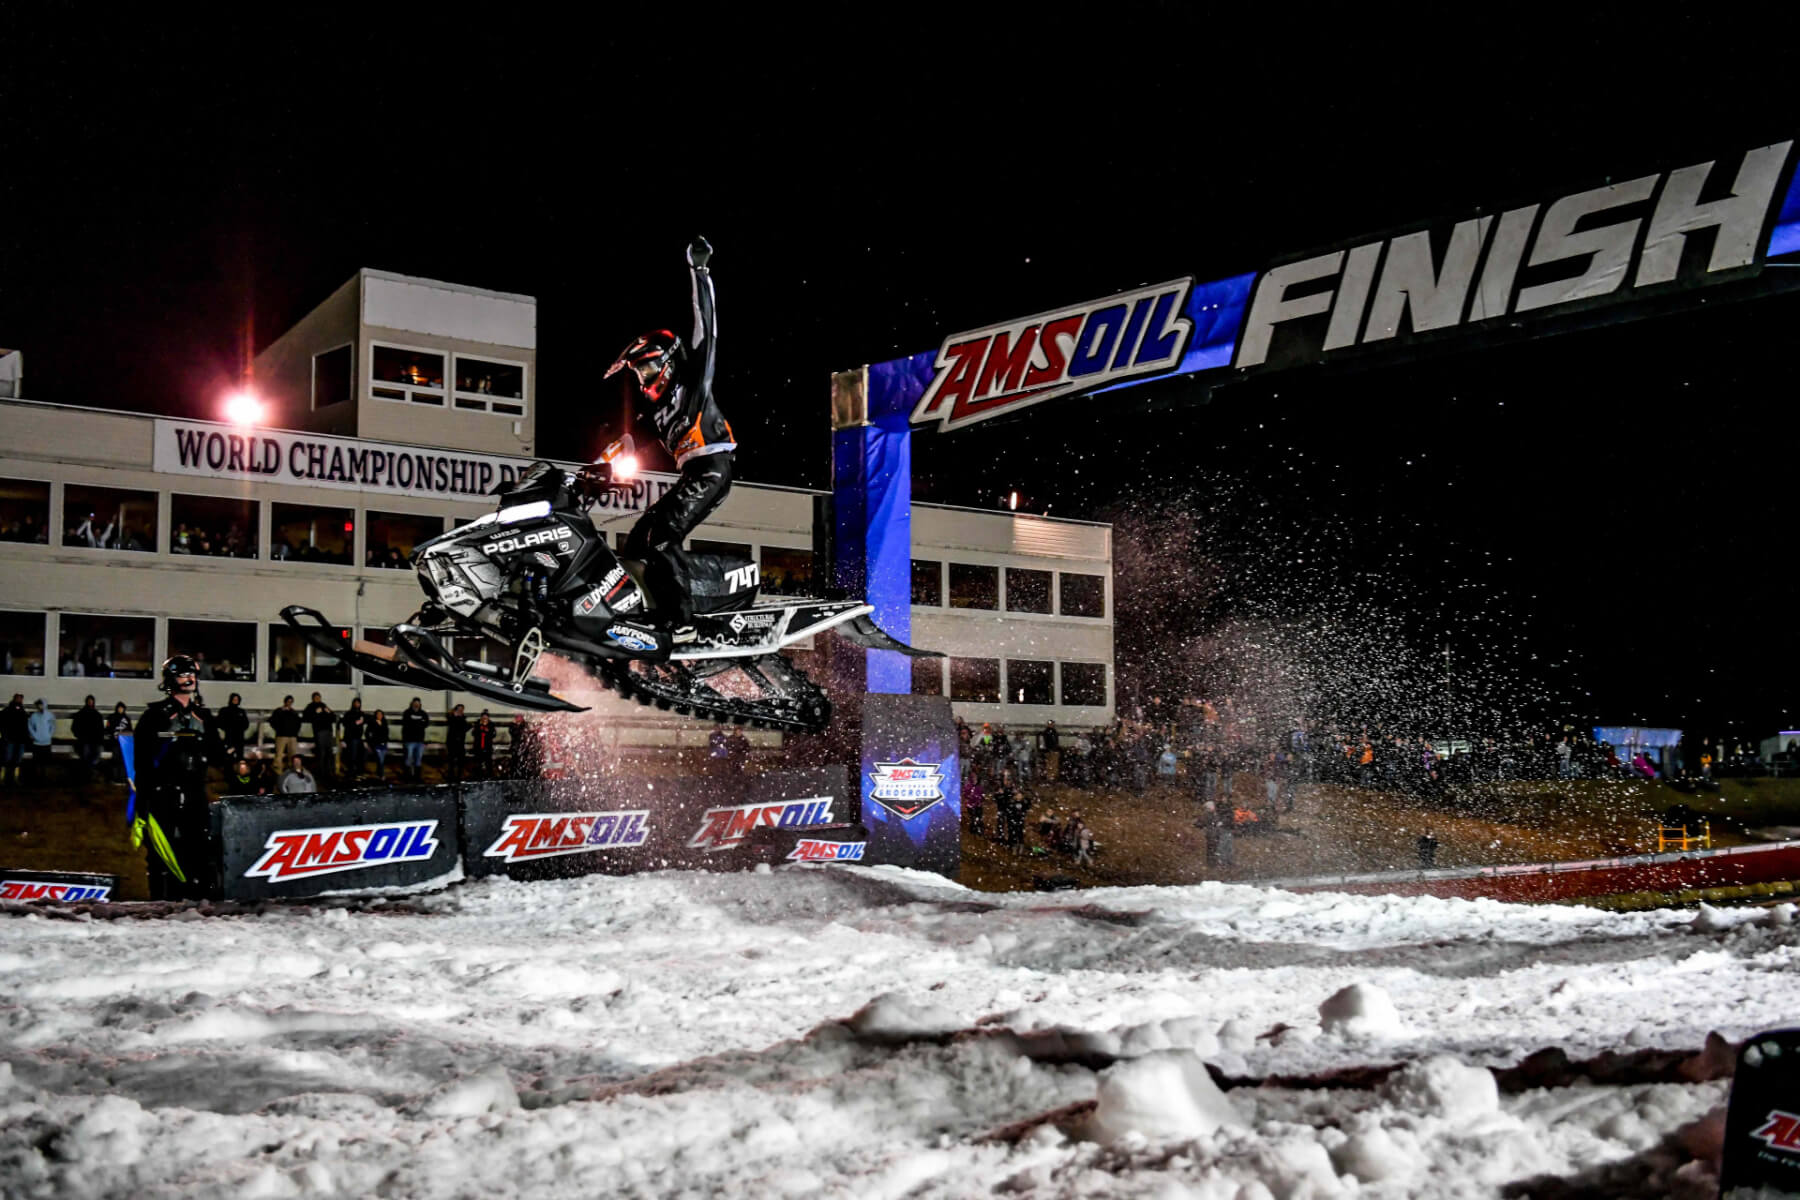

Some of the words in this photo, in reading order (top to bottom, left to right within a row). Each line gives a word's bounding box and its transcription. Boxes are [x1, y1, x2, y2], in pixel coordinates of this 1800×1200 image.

[1234, 140, 1794, 369] FINISH
[922, 289, 1183, 421] AMSOIL
[174, 429, 281, 475] WORLD
[288, 441, 493, 495] CHAMPIONSHIP
[483, 526, 573, 556] POLARIS
[724, 553, 760, 594] 747
[495, 814, 647, 858] AMSOIL
[694, 801, 833, 847] AMSOIL
[257, 825, 434, 877] AMSOIL
[792, 840, 865, 861] AMSOIL
